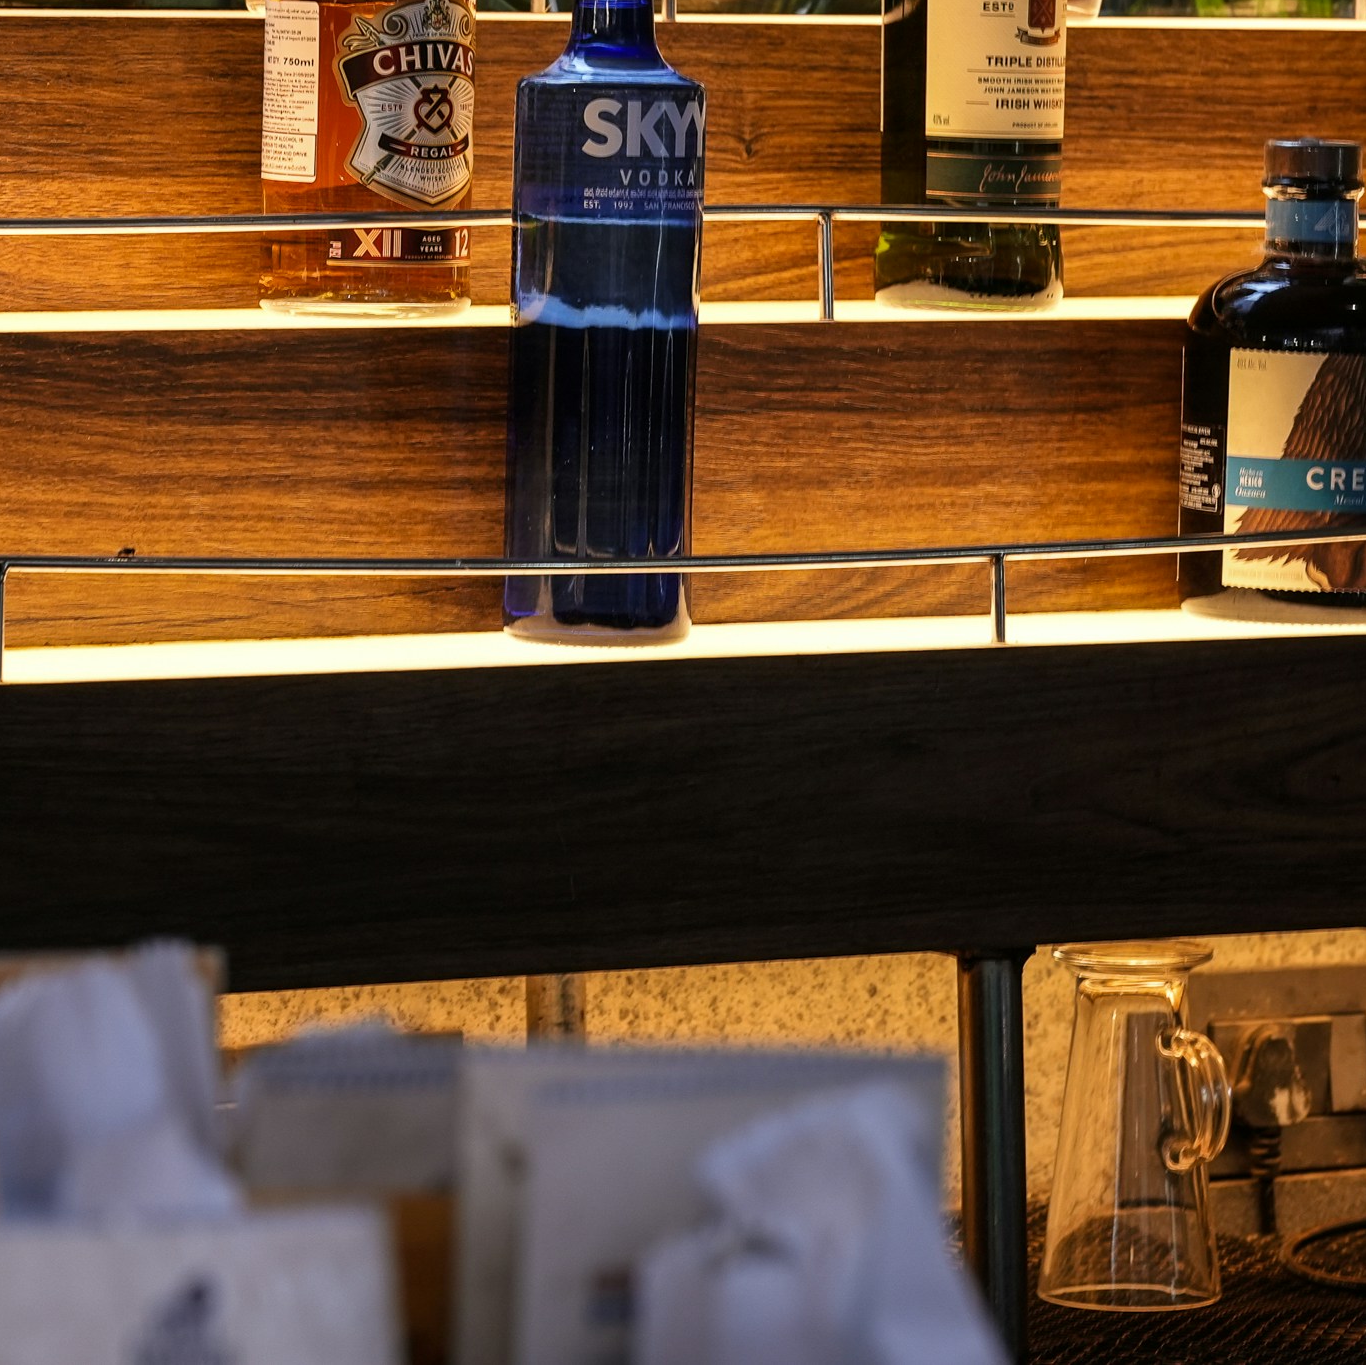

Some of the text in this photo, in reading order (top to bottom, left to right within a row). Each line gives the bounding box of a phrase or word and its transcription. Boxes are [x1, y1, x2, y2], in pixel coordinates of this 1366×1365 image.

[283, 57, 314, 67] 750ml
[373, 43, 473, 76] CHIVAS
[986, 55, 1032, 68] TRIPLE
[978, 77, 1011, 85] SMOOTH
[996, 98, 1030, 110] IRISH
[410, 145, 455, 158] REGAL
[400, 163, 462, 175] BLENDED SCOTCH
[620, 169, 695, 187] VODKA
[979, 163, 1015, 193] John
[583, 199, 695, 211] EST. 1992 SAN FRANCISCO
[353, 228, 402, 257] XII
[420, 245, 443, 253] YEARS
[455, 228, 469, 257] 12
